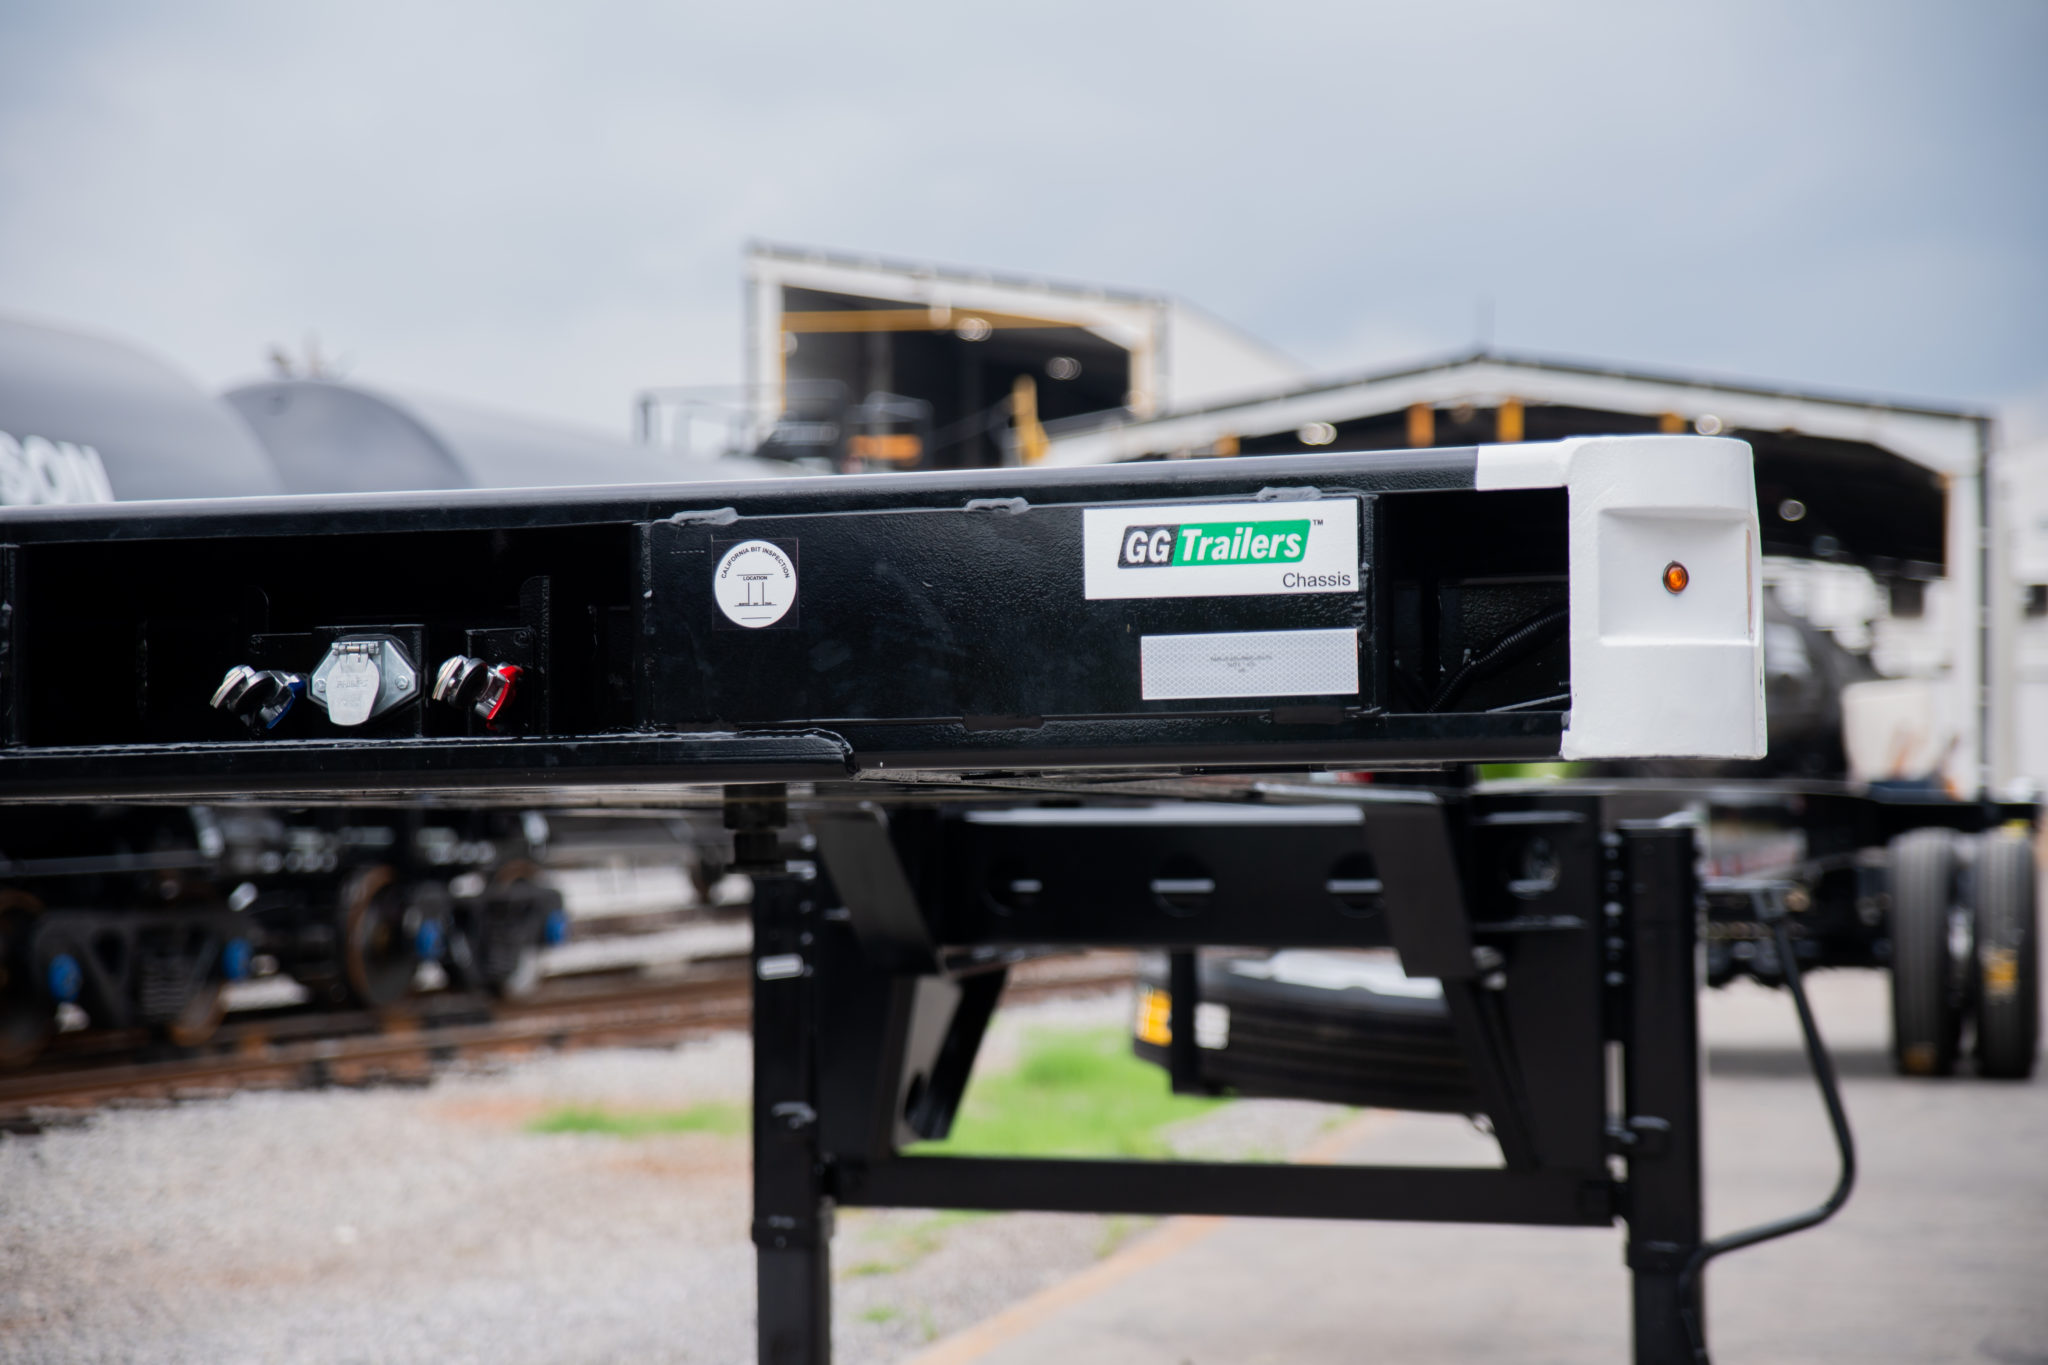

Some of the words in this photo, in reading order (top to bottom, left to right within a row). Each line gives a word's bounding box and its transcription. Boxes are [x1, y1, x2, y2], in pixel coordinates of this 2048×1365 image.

[1125, 530, 1172, 564] GG
[1182, 527, 1302, 562] Trailers
[721, 547, 749, 579] CALIFORNIA
[762, 547, 790, 579] INSPECTION
[1282, 571, 1351, 588] Chassis
